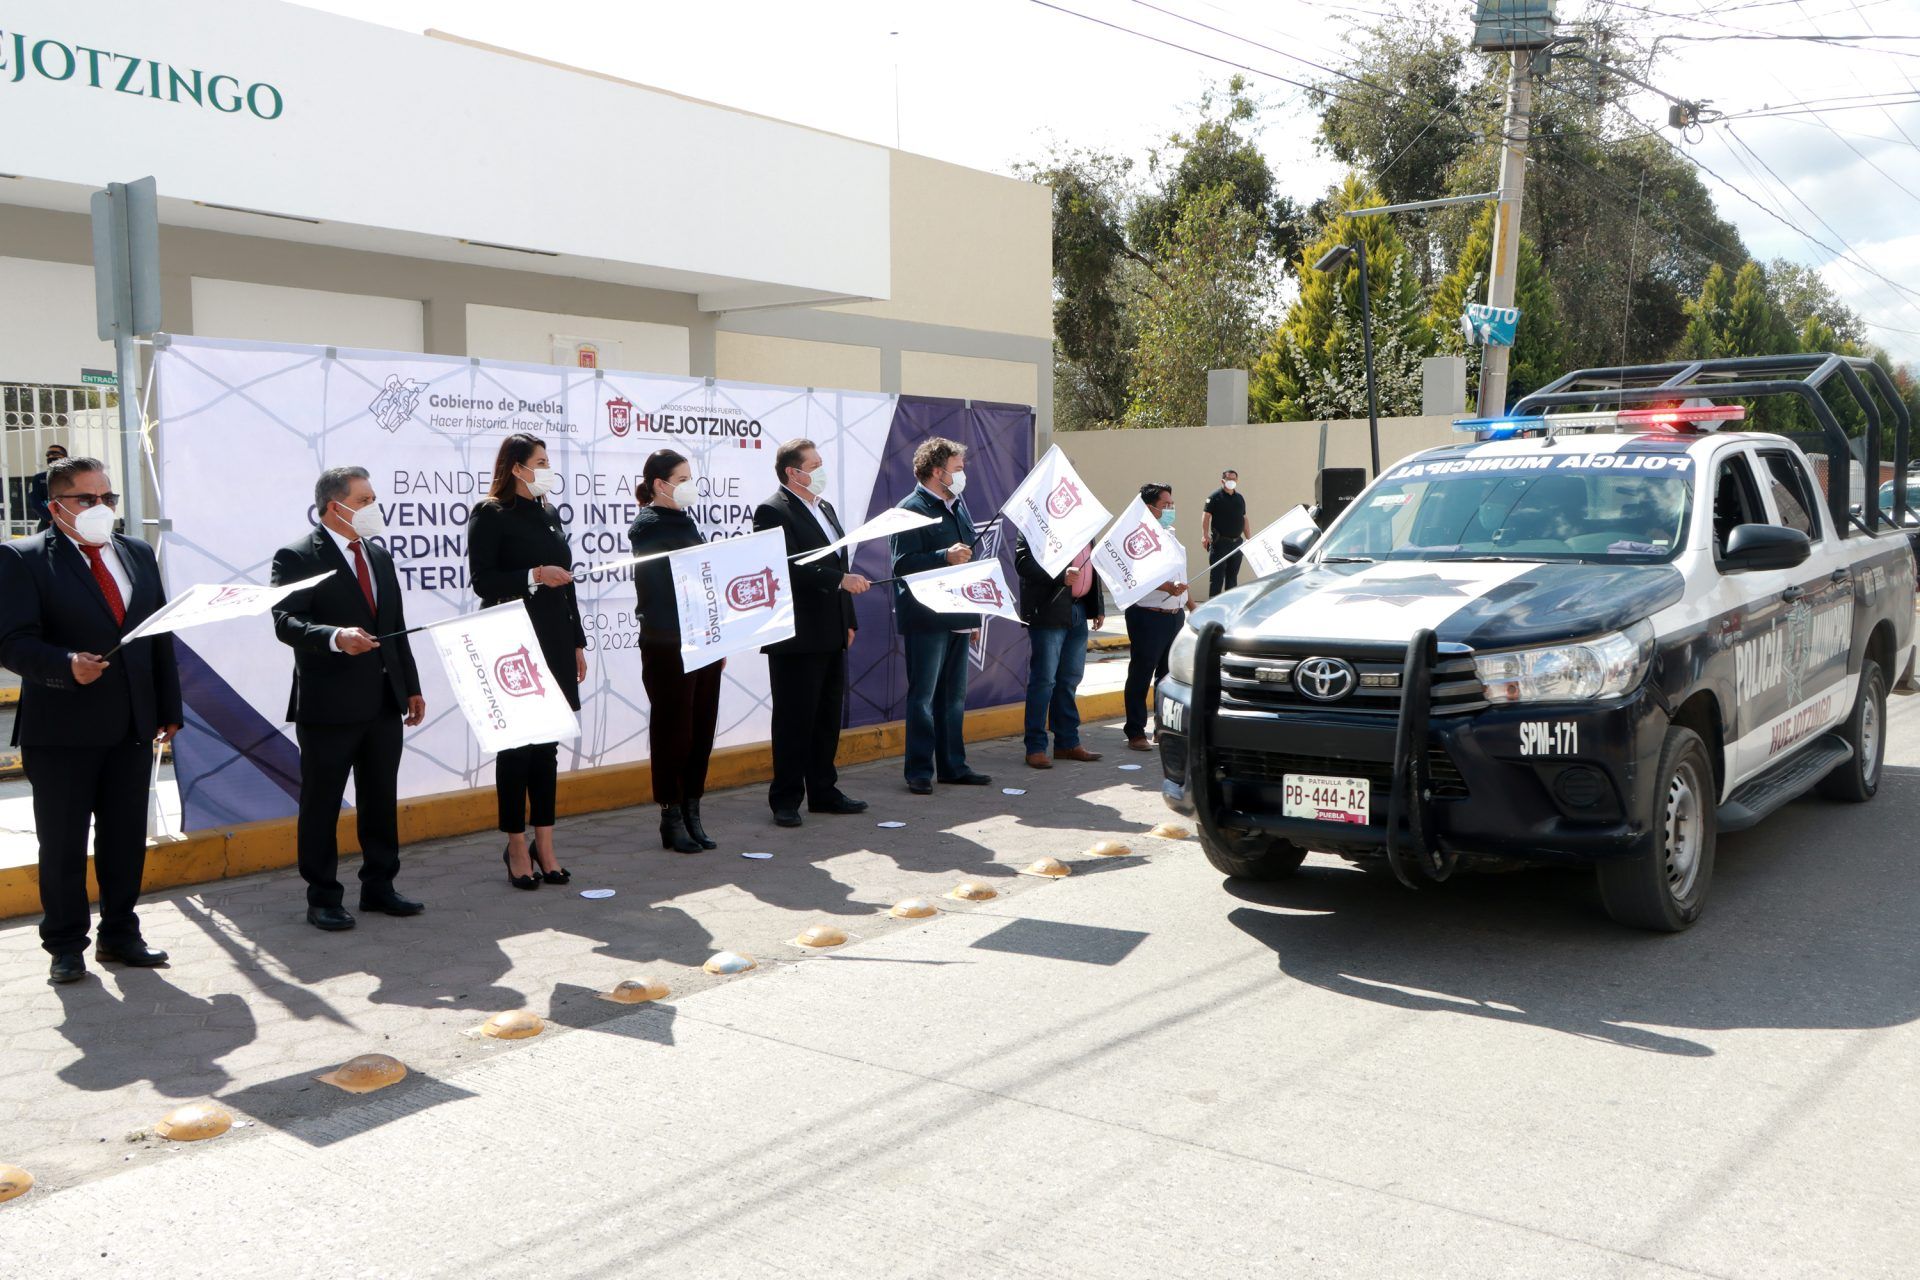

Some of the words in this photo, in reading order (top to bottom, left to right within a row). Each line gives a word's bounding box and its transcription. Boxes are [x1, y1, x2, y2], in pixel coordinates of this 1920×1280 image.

[82, 374, 119, 385] ENTRADA
[429, 394, 494, 410] Gobierno
[498, 398, 515, 411] de
[518, 400, 564, 414] Puebla
[683, 405, 705, 413] SOMOS
[718, 408, 742, 416] FUERTES
[430, 414, 463, 427] Hacer
[465, 416, 509, 429] historia.
[512, 419, 543, 431] Hacer
[545, 419, 579, 434] futuro.
[636, 413, 762, 438] HUEJOTZINGO
[393, 470, 566, 496] BANDEO
[575, 473, 607, 496] DE
[1025, 496, 1063, 550] HUEJOTZINGO
[701, 561, 721, 643] HUEJOTZINGO
[601, 631, 640, 651] 2022
[1735, 617, 1783, 707] POLICÍA
[461, 633, 506, 729] HUEJOTZINGO
[1769, 695, 1832, 756] HUEJOTZINGO
[1519, 721, 1578, 756] SPM-171
[1309, 778, 1342, 786] PATRULLA
[1286, 785, 1366, 810] PB-444-A2
[1318, 811, 1345, 819] PUEBLA
